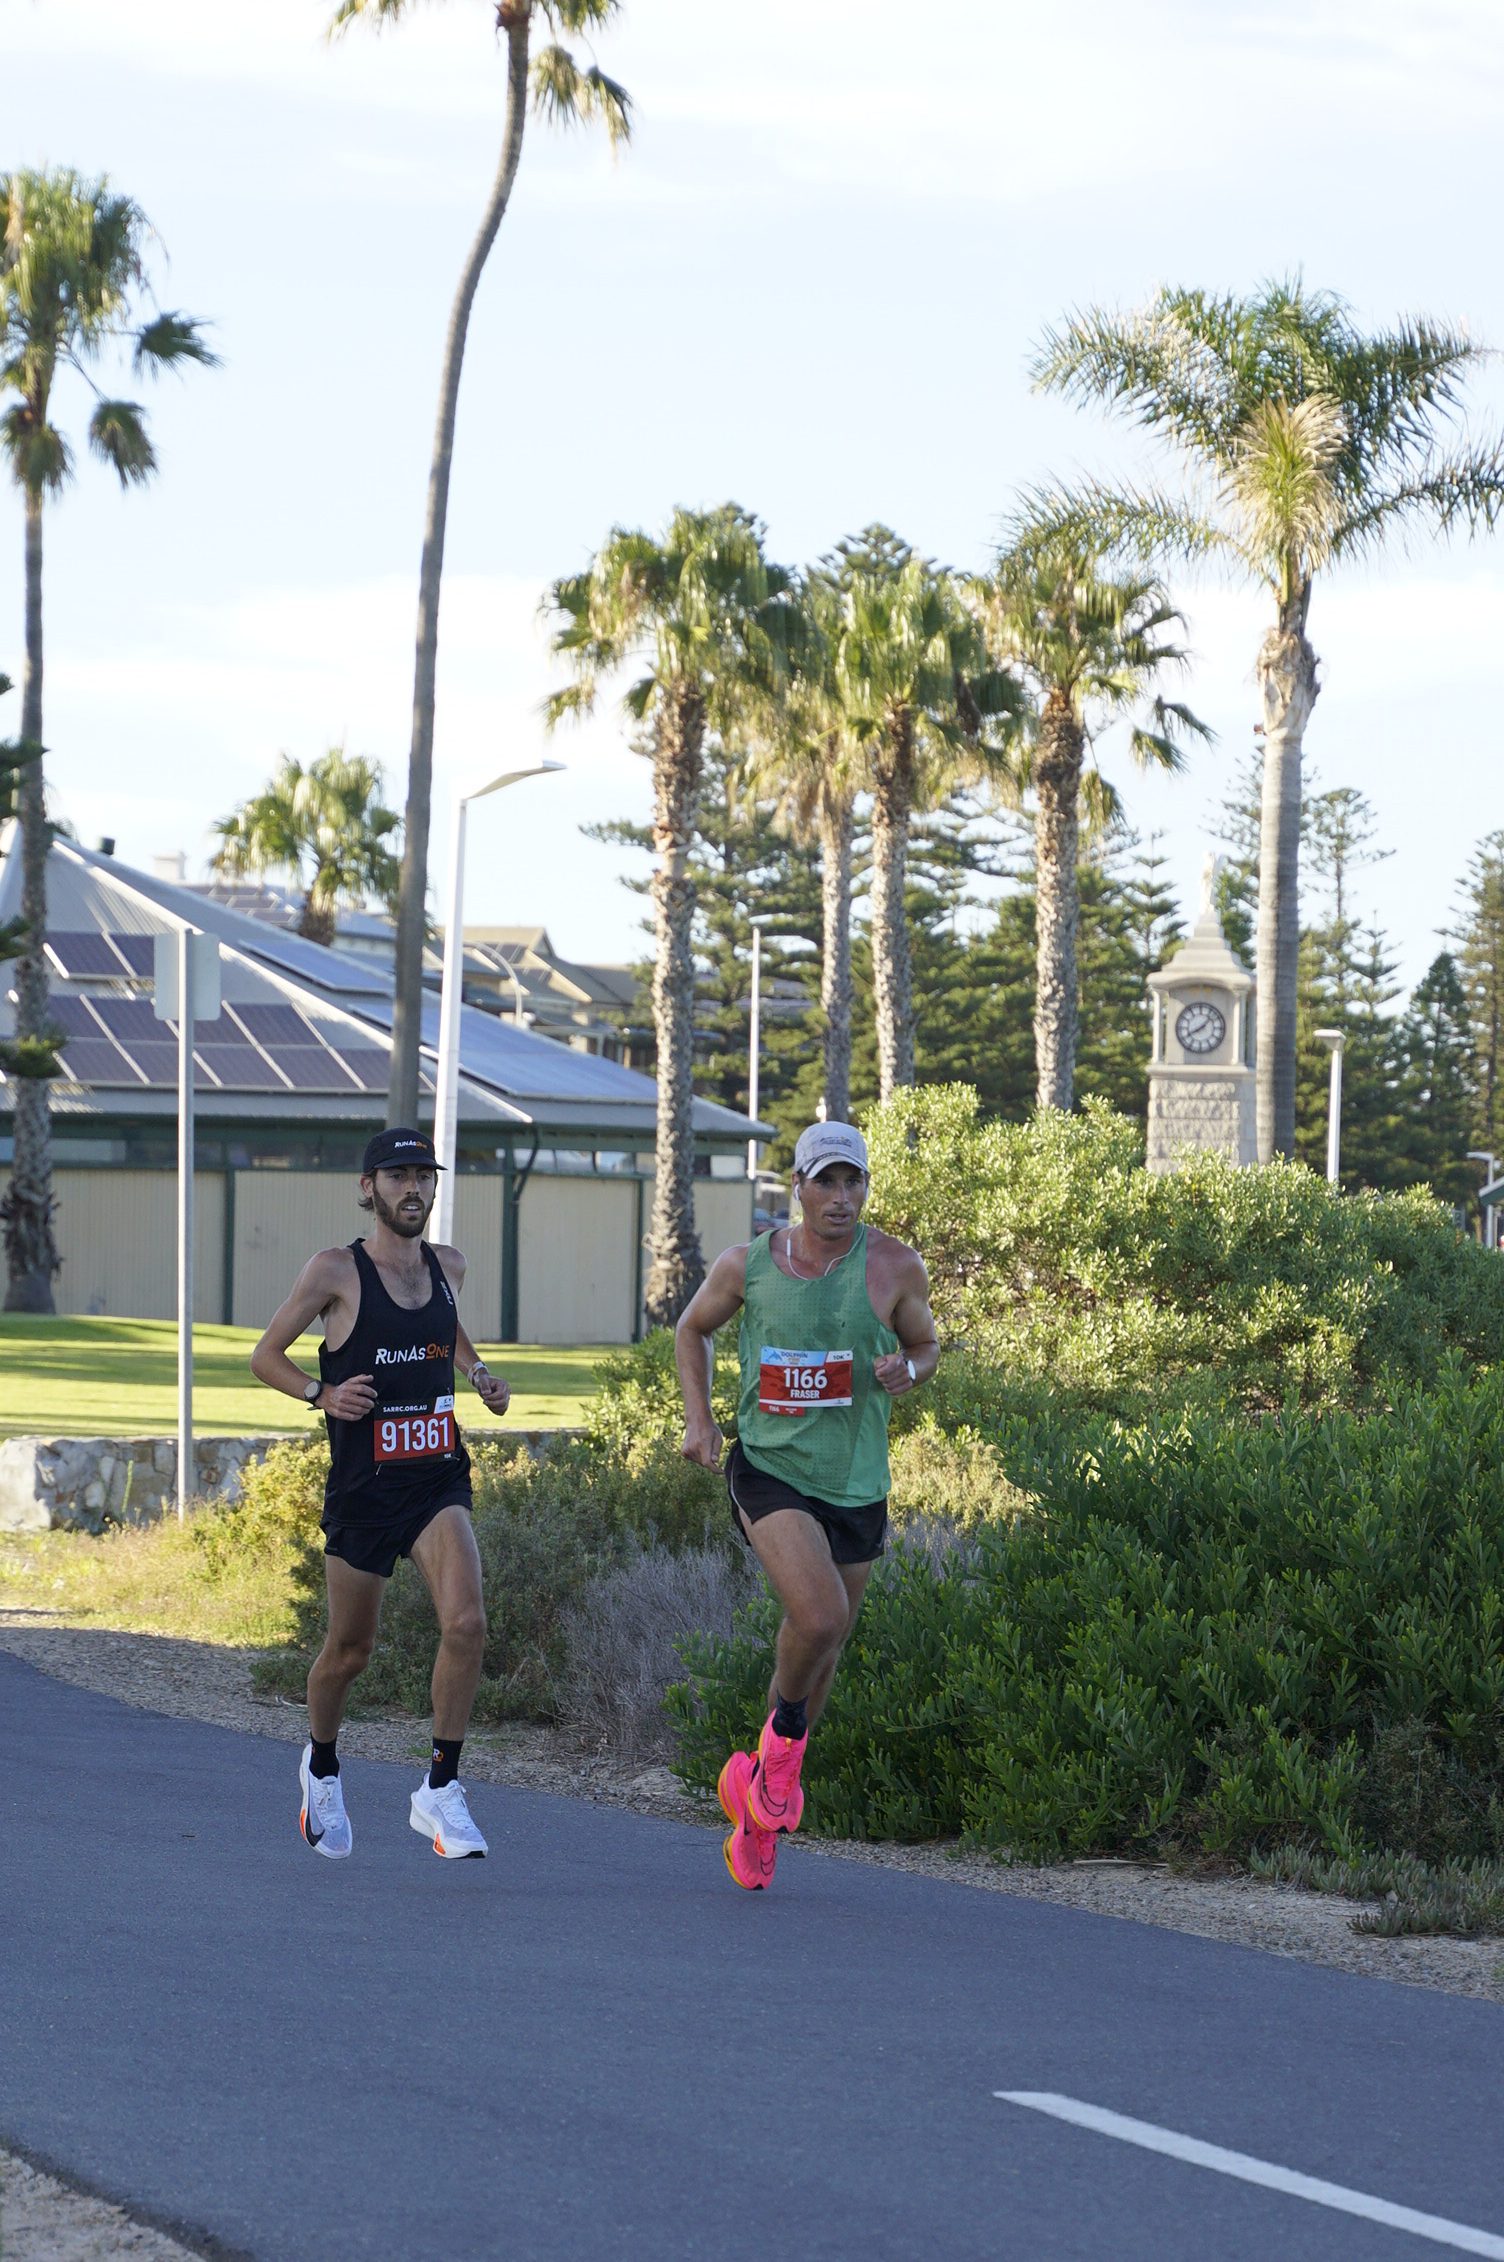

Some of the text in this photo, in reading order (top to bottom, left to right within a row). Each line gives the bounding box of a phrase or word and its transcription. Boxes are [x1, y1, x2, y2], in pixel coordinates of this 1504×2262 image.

[784, 1367, 828, 1389] 1166
[790, 1389, 820, 1399] FRASER
[381, 1416, 449, 1452] 91361
